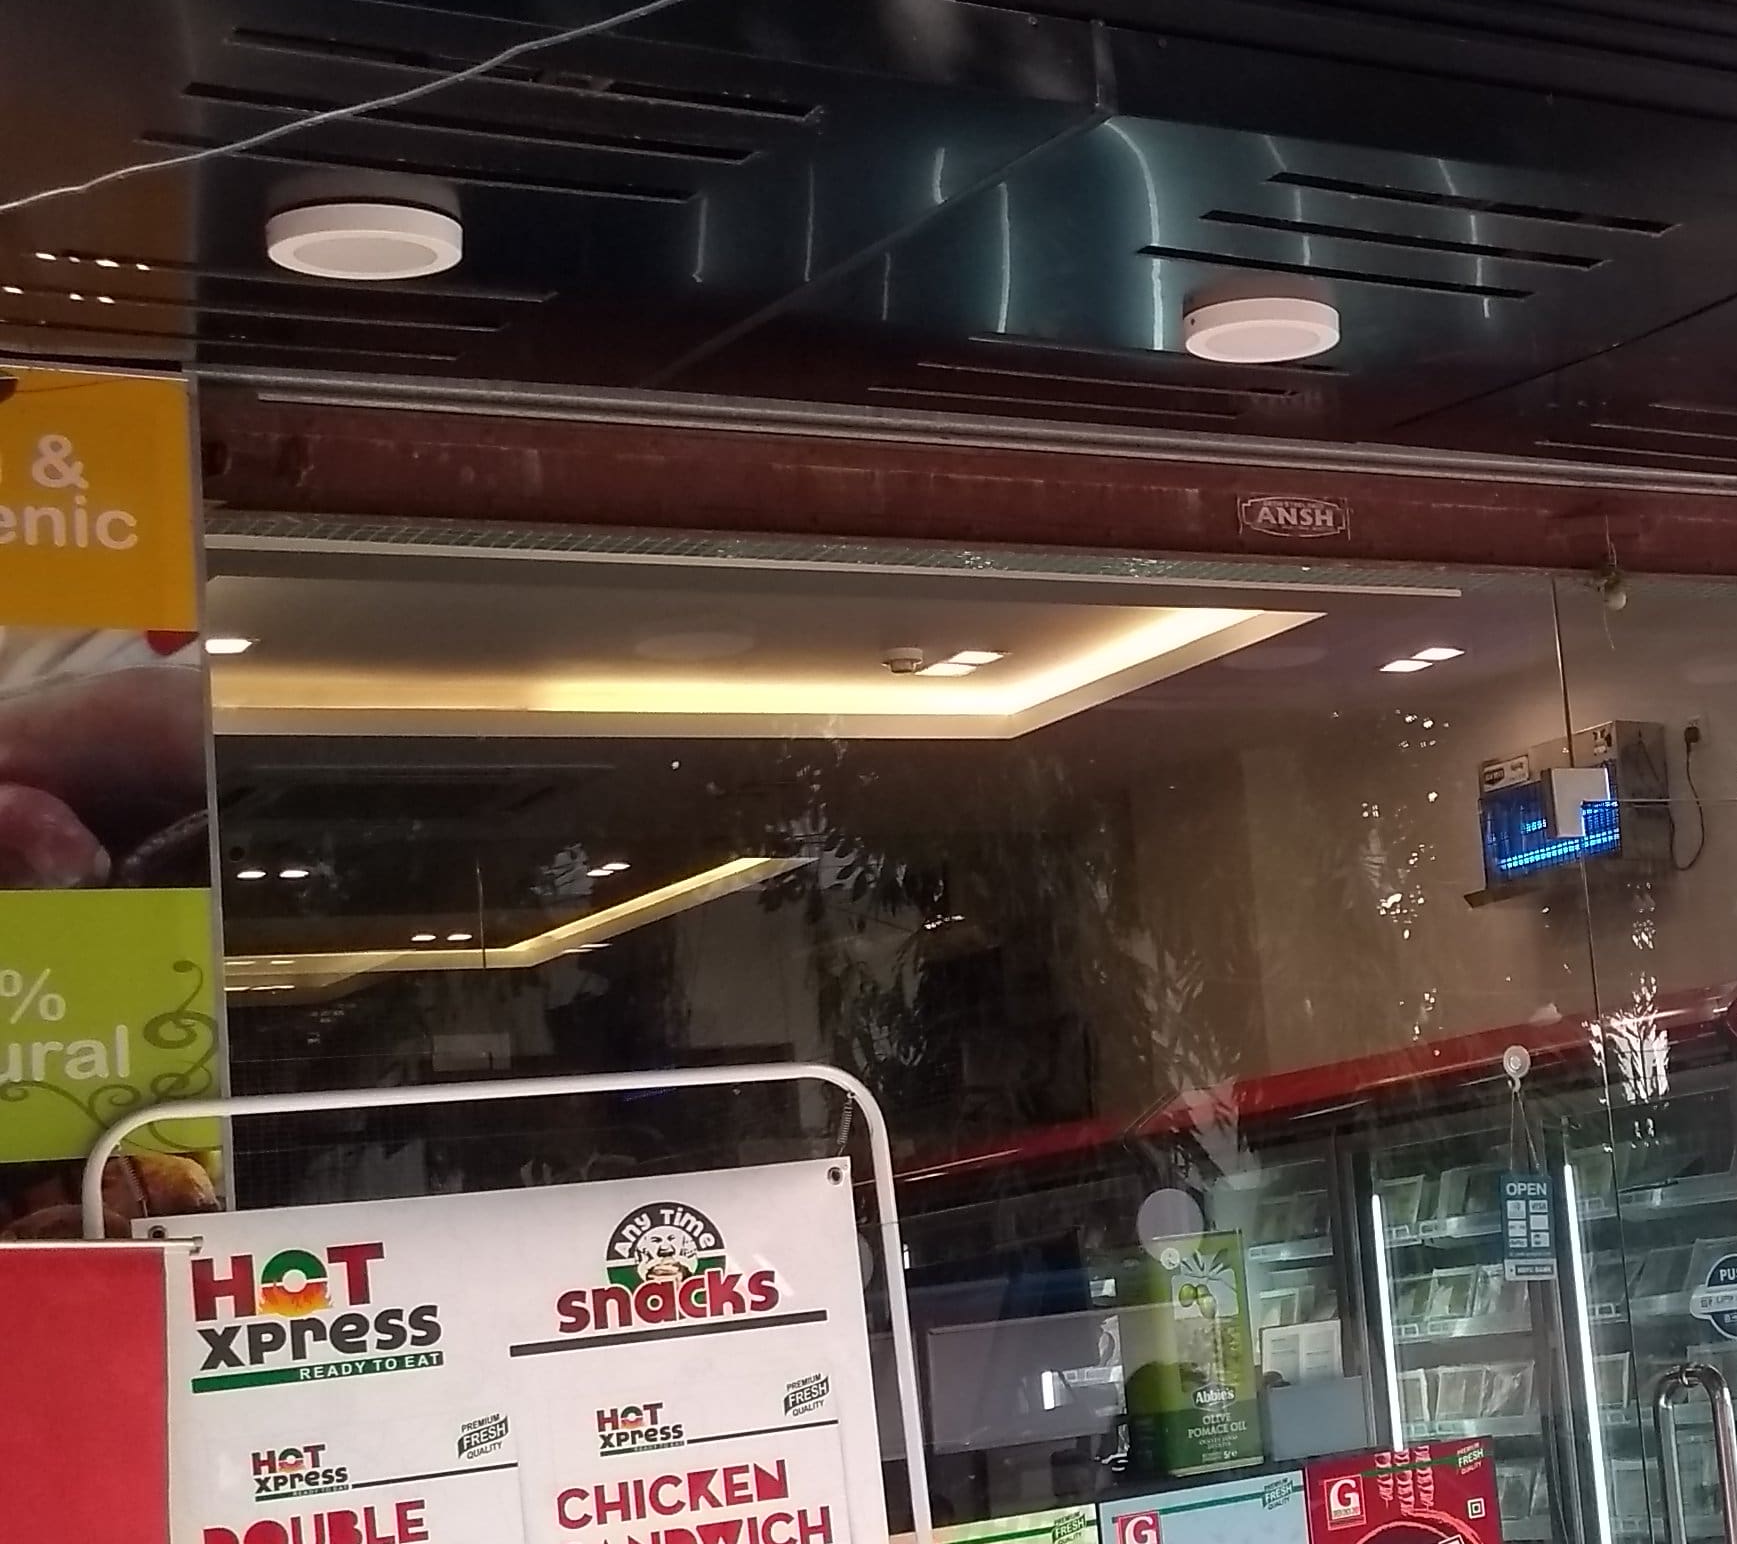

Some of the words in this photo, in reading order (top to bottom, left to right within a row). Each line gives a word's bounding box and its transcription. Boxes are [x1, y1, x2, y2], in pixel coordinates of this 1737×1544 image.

[32, 434, 89, 489] &
[1258, 507, 1333, 526] ANSH
[1506, 1182, 1547, 1196] OPEN
[659, 1207, 717, 1251] Time
[191, 1242, 385, 1322] HOT
[557, 1270, 780, 1334] snacks
[300, 1360, 366, 1380] READY
[375, 1357, 397, 1372] TO
[405, 1352, 441, 1369] EAT
[786, 1373, 821, 1392] PREMIUM
[789, 1382, 827, 1408] FRESH
[1195, 1386, 1236, 1405] Abbie's
[596, 1402, 663, 1433] HOT
[792, 1399, 824, 1417] QUALITY
[462, 1413, 499, 1432] PREMIUM
[1202, 1413, 1231, 1425] OLIVE
[463, 1423, 506, 1450] FRESH
[1187, 1424, 1229, 1439] POMACE
[1230, 1421, 1247, 1433] OIL
[251, 1444, 325, 1476] HOT
[467, 1441, 502, 1459] QUALITY
[1458, 1448, 1484, 1468] FRESH
[557, 1459, 789, 1529] CHICKEN
[1266, 1484, 1293, 1504] FRESH
[1055, 1516, 1086, 1539] FRESH
